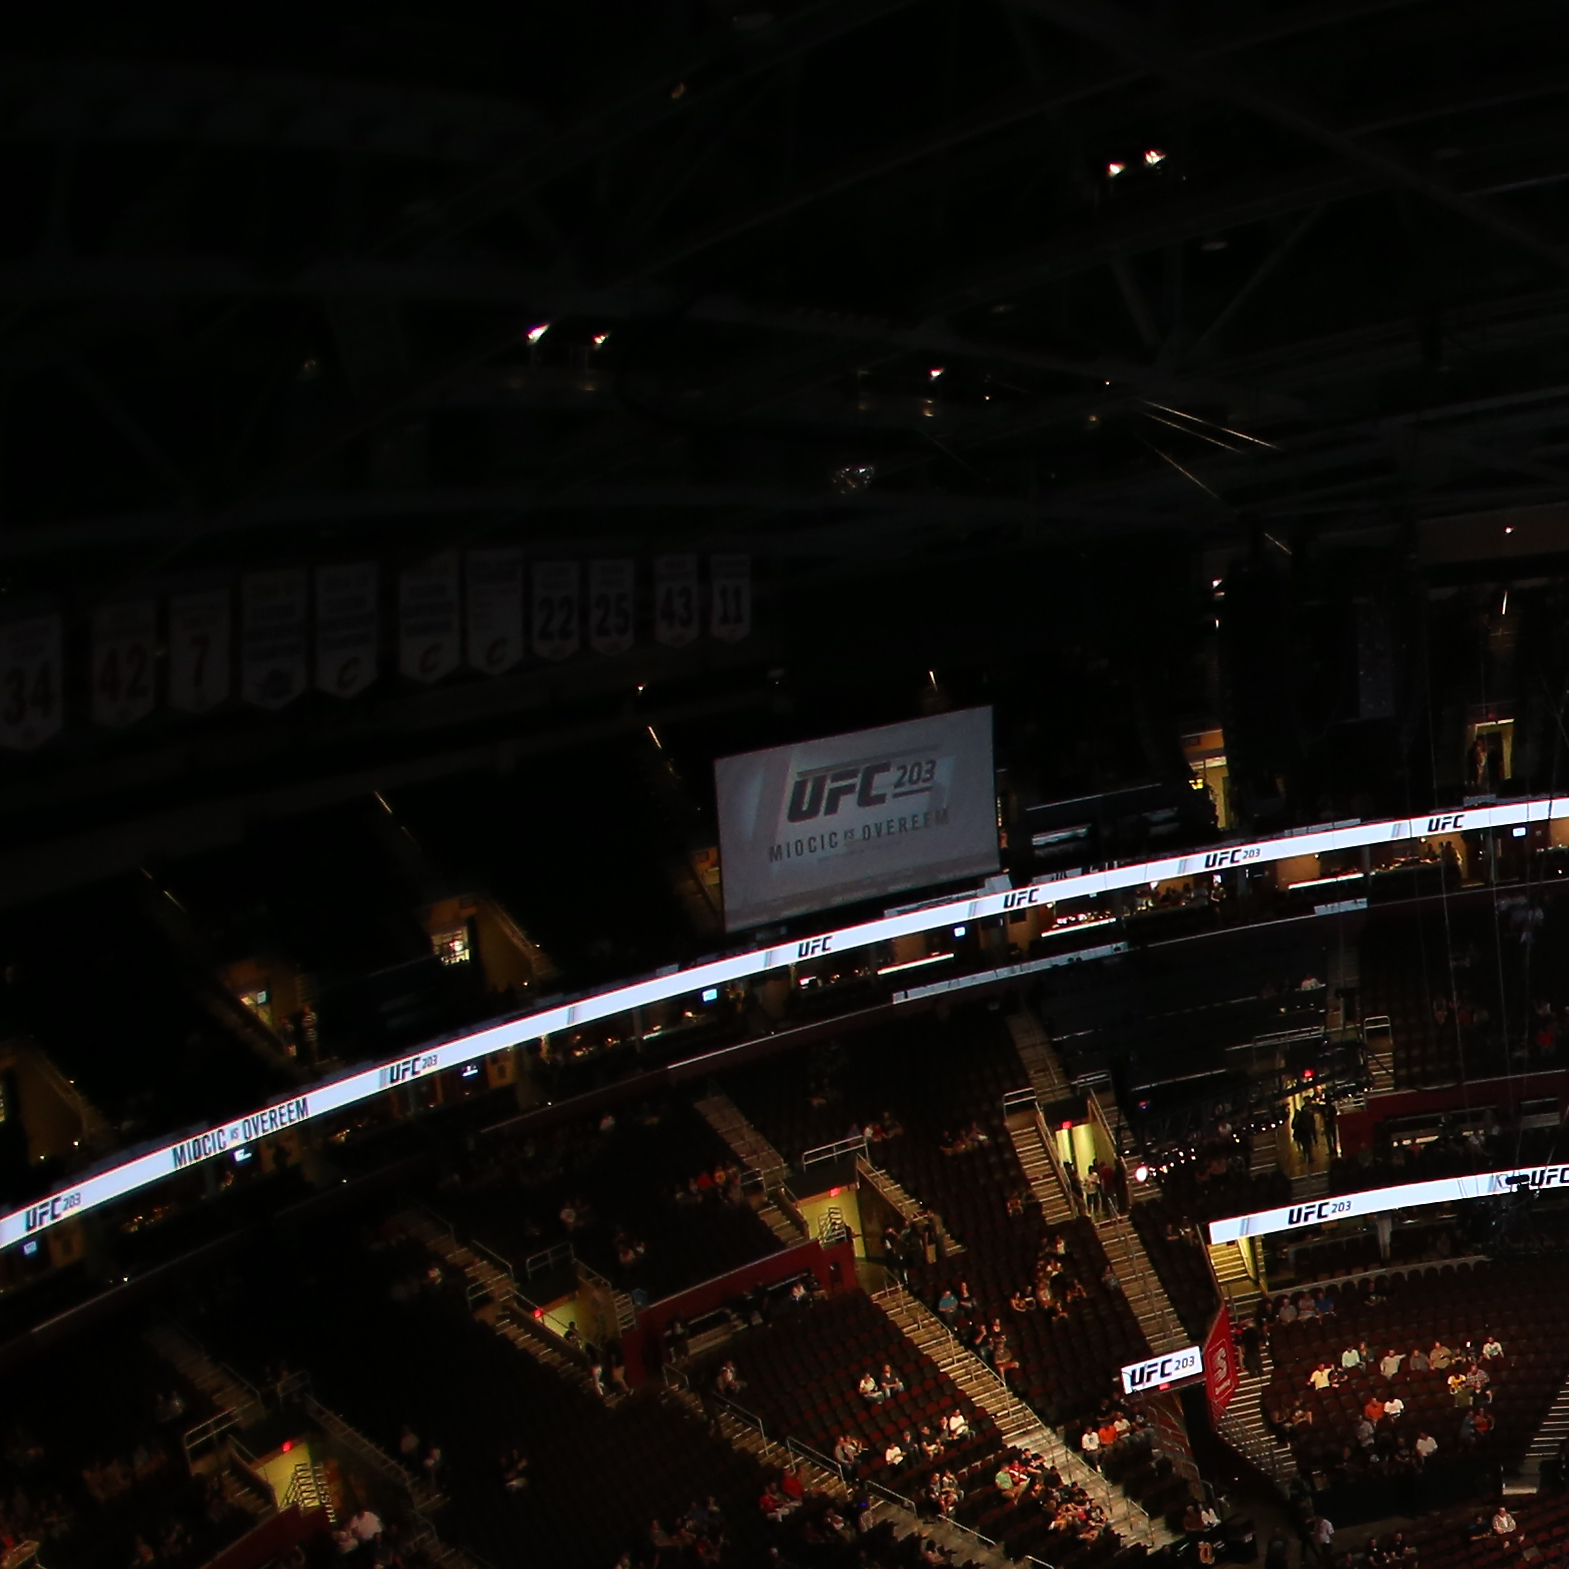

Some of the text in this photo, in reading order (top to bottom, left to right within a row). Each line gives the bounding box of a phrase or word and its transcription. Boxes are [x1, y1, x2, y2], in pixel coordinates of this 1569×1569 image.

[538, 595, 575, 640] 22
[595, 592, 631, 637] 25
[660, 586, 693, 628] 43
[97, 642, 148, 702] 42
[3, 660, 53, 726] 34
[788, 760, 937, 824] UFC 203
[769, 831, 839, 863] MIOCIC
[861, 809, 950, 841] OVEREEM
[1428, 815, 1464, 832] UFC
[1204, 848, 1260, 868] UFC 203
[1003, 888, 1039, 908] UFC
[798, 936, 832, 958] UFC
[390, 1055, 438, 1084] UFC 203
[172, 1129, 227, 1169] MIOCIC
[243, 1097, 309, 1140] OVEREEM
[26, 1193, 81, 1231] UFC 203
[1288, 1201, 1351, 1225] UFC 203
[1131, 1356, 1194, 1386] UFC 203
